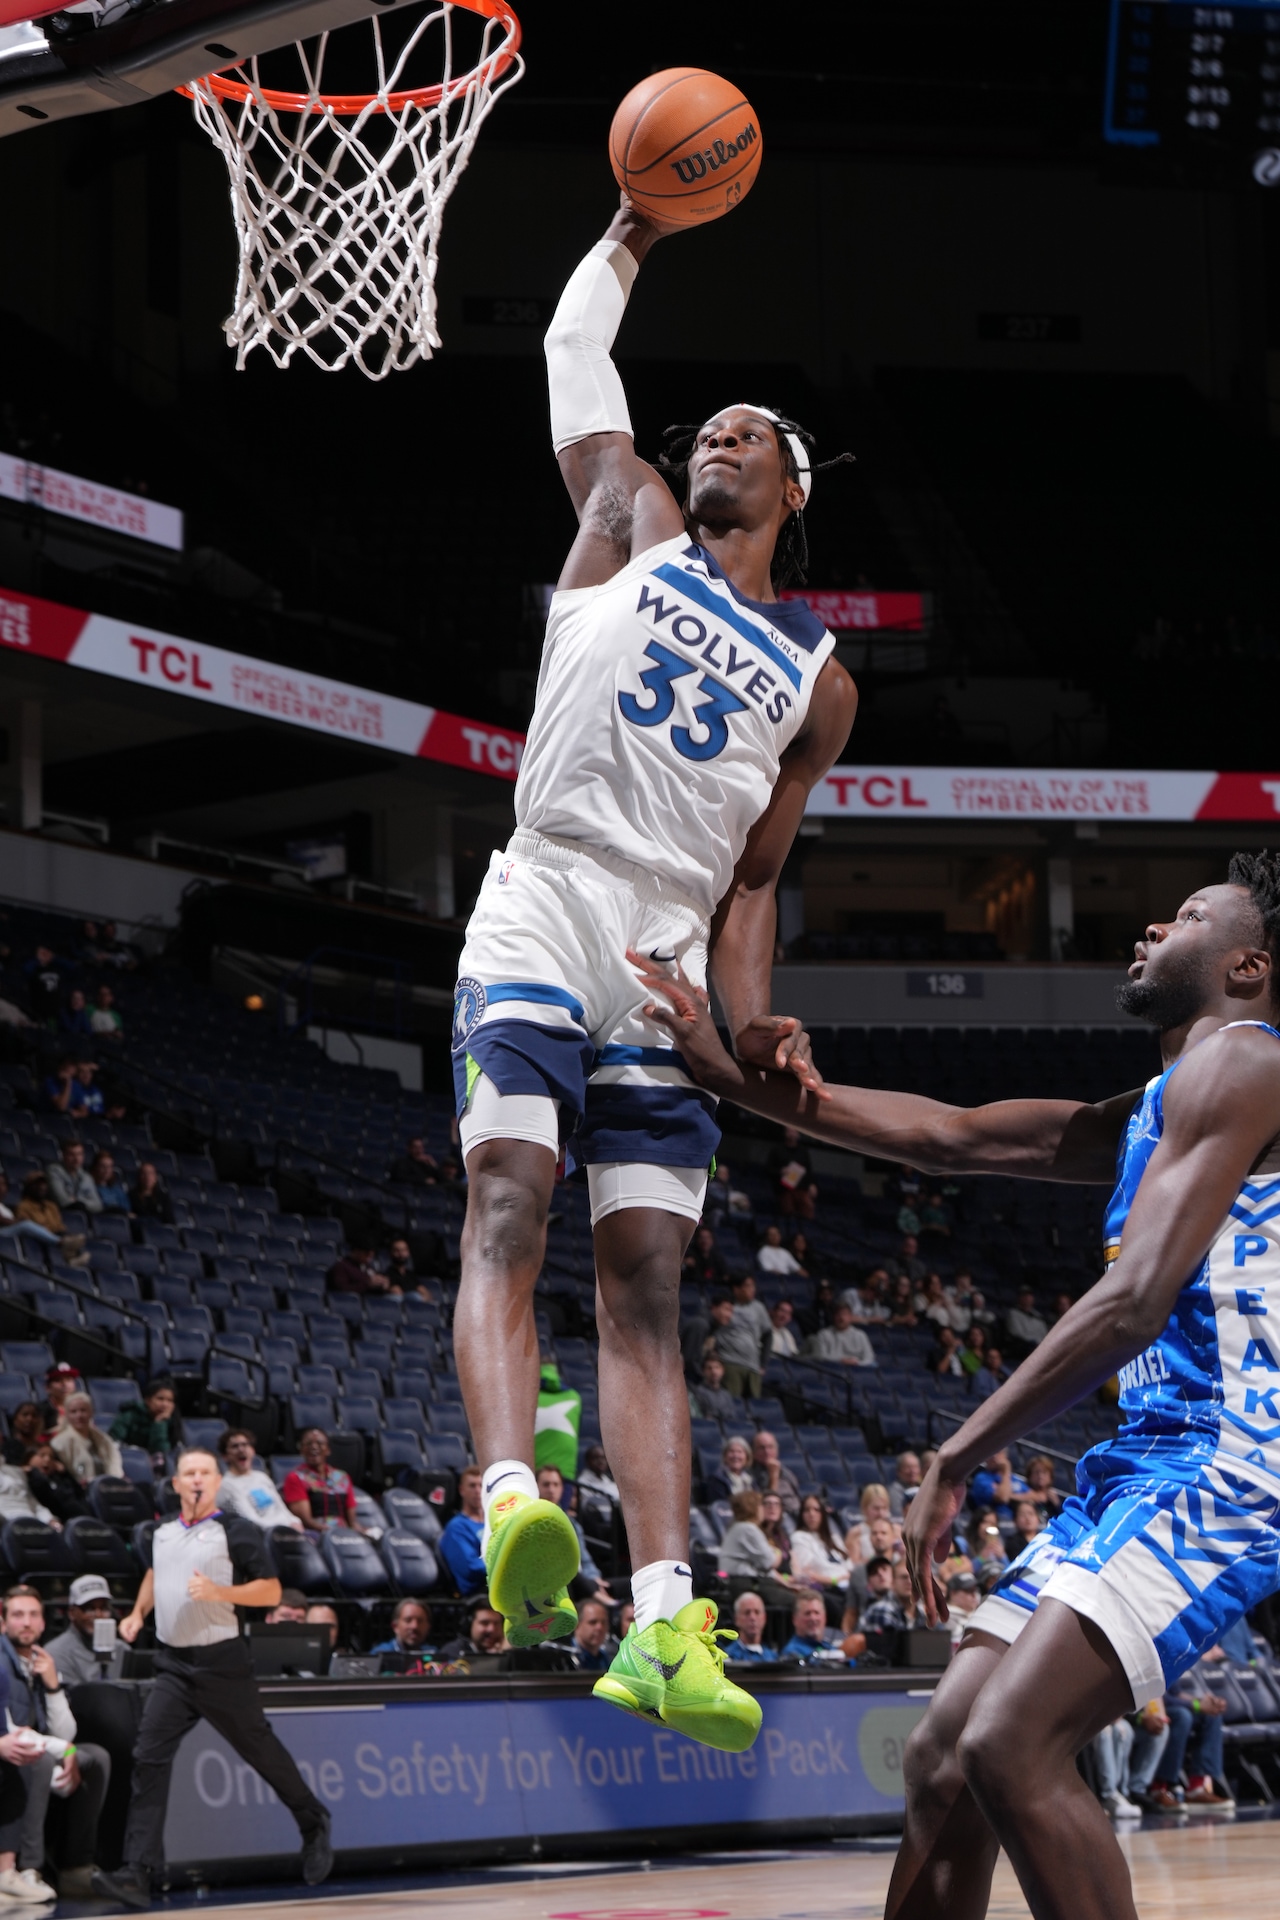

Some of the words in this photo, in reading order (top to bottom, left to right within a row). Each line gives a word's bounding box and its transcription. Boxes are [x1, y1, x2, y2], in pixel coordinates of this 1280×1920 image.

[670, 122, 758, 184] Wilson
[129, 635, 213, 691] TCL
[636, 584, 792, 724] WOLVES
[231, 664, 302, 698] OFFICIAL
[307, 684, 326, 701] TV
[331, 692, 350, 708] OF
[354, 697, 383, 720] THE
[232, 681, 383, 739] TIMBERWOLVES
[618, 639, 749, 761] 33
[826, 776, 929, 808] TCL
[951, 777, 1042, 794] OFFICIAL
[1048, 779, 1073, 794] TV
[1078, 779, 1104, 794] OF
[1112, 780, 1148, 795] THE
[952, 795, 1151, 813] TIMBERWOLVES
[926, 974, 966, 994] 136
[354, 1741, 489, 1806] Safety
[499, 1736, 554, 1790] for
[559, 1735, 645, 1787] Your
[763, 1727, 850, 1777] Pack
